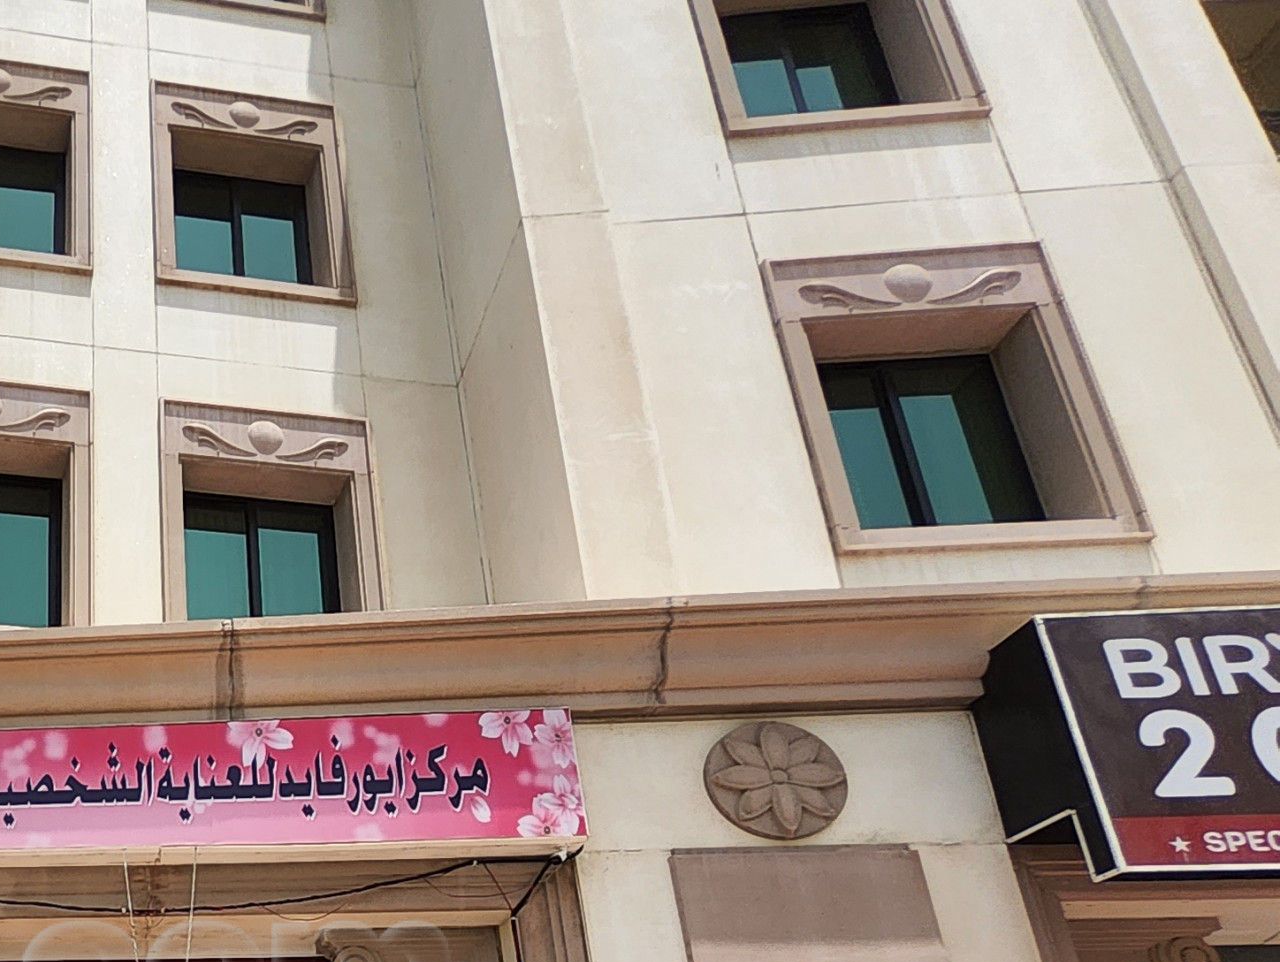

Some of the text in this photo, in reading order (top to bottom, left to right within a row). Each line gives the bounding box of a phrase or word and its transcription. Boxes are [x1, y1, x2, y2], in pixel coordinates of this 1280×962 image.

[157, 747, 277, 824] للعناية
[405, 744, 490, 812] مركز
[1139, 708, 1236, 798] 2
